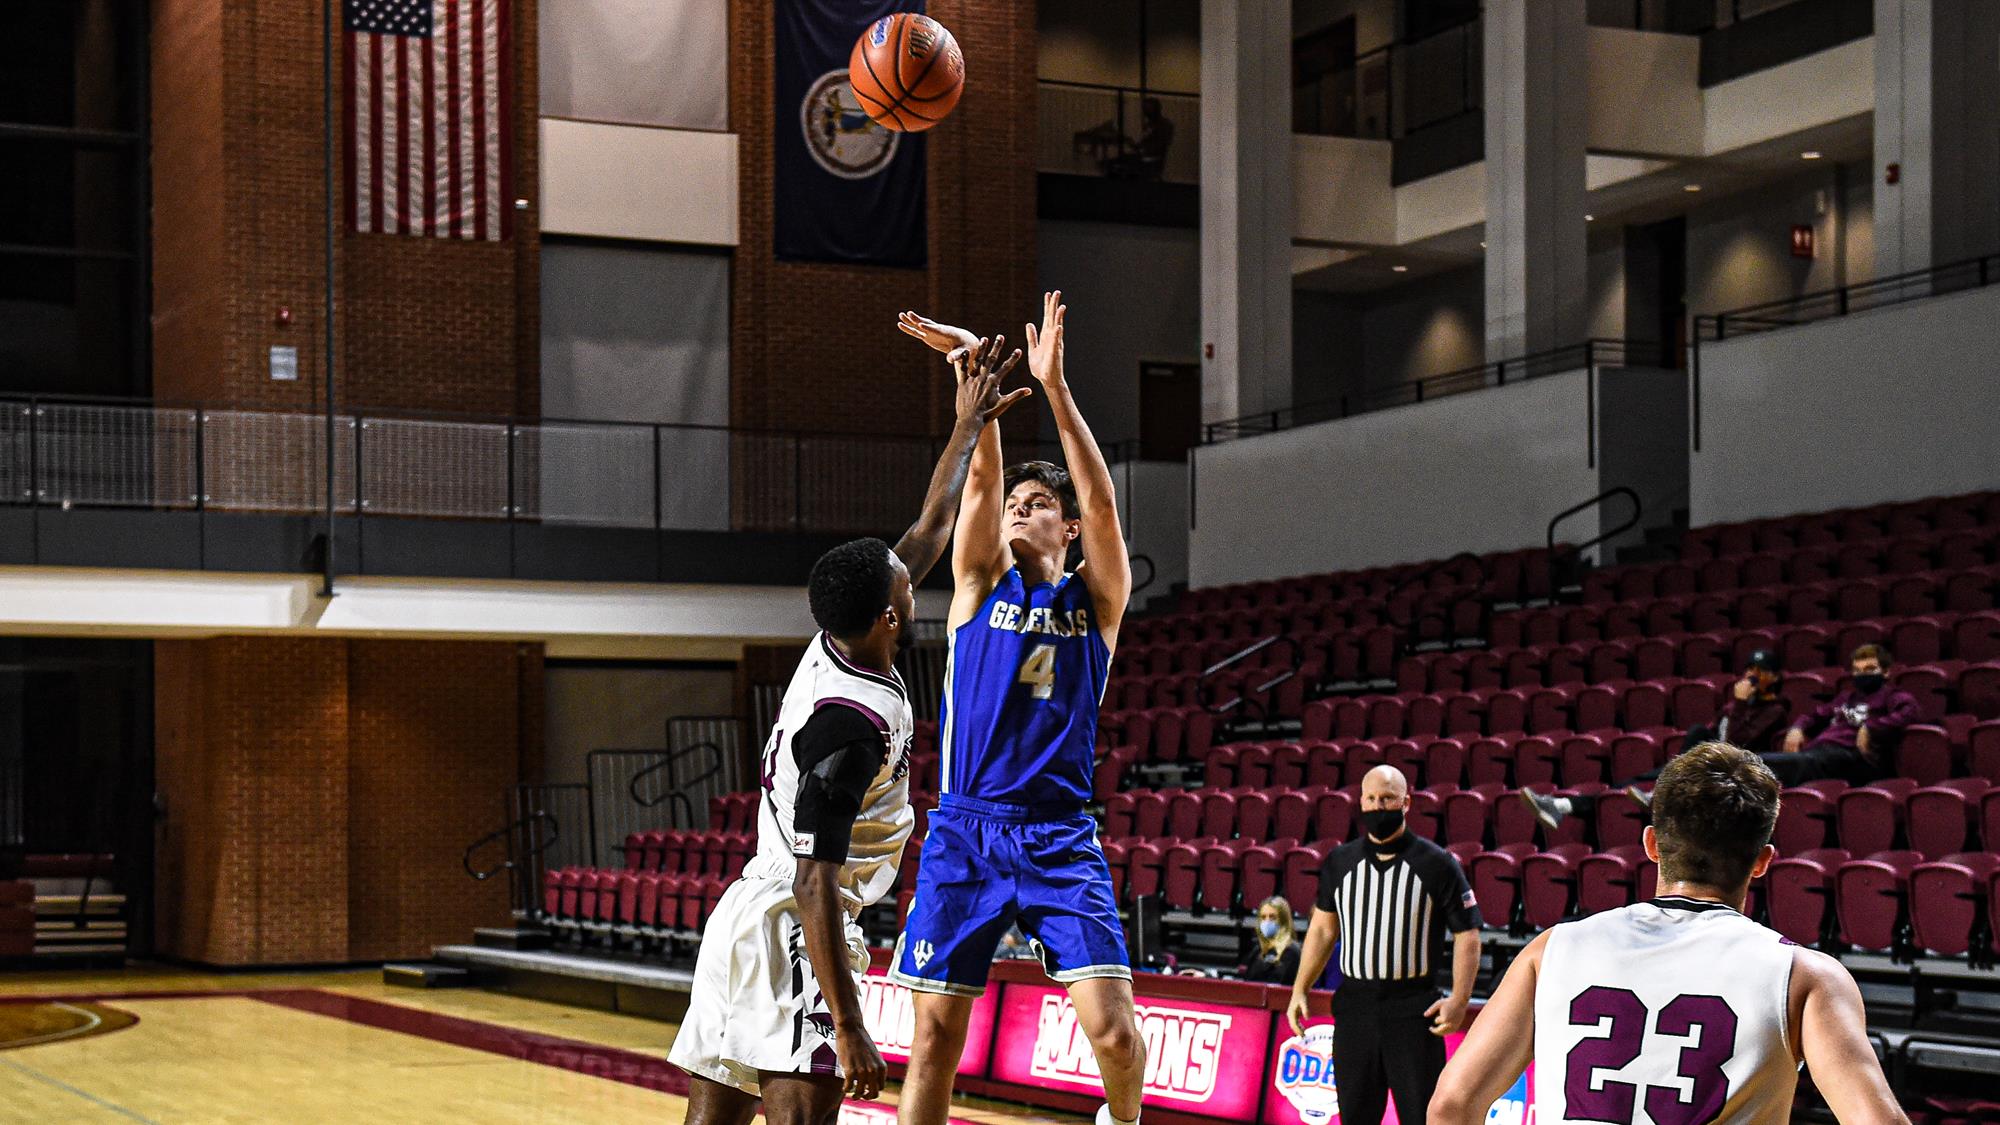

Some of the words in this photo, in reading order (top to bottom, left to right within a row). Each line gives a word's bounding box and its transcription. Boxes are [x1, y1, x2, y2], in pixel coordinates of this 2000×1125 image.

[989, 600, 1088, 637] GEERS
[1019, 643, 1057, 699] 4
[1033, 1000, 1223, 1094] MAONS
[1282, 1048, 1337, 1086] ODA
[1562, 985, 1739, 1125] 23
